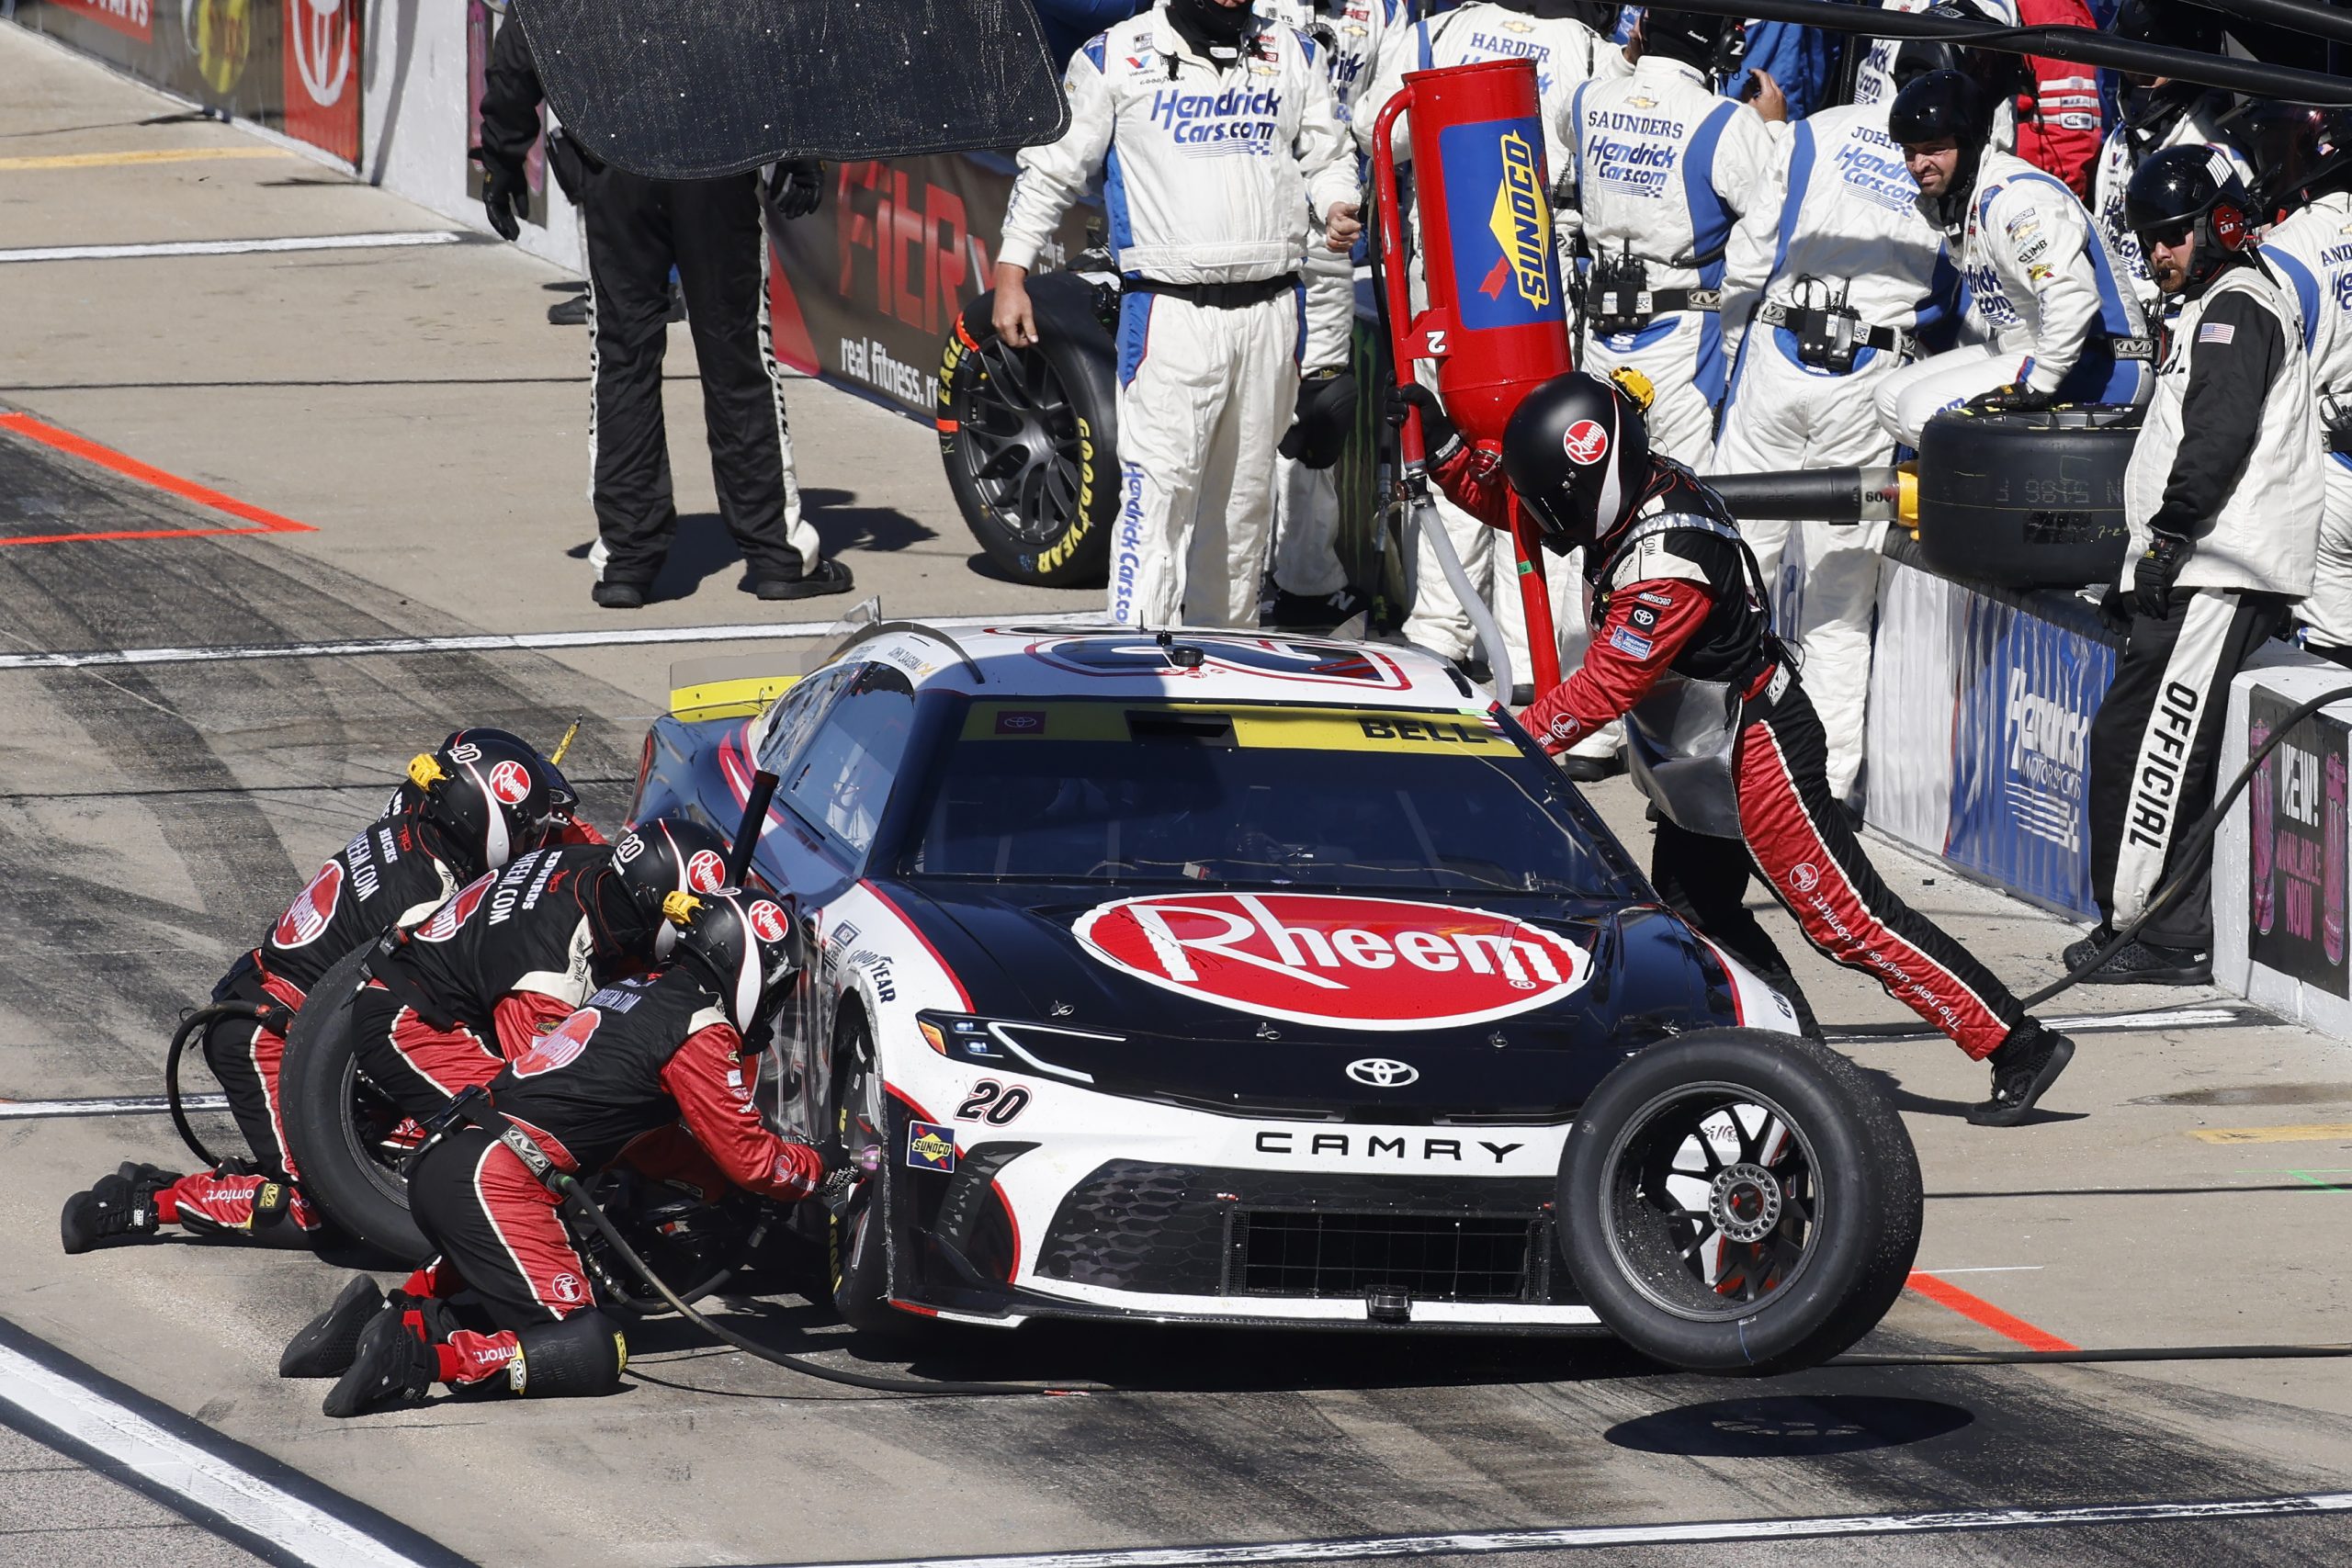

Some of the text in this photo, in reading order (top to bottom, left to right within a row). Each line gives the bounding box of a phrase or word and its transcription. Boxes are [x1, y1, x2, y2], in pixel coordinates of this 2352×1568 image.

[1470, 32, 1551, 63] HARDER
[1150, 86, 1282, 130] Hendrick
[1588, 110, 1685, 140] SAUNDERS
[1174, 120, 1276, 143] Cars.com
[1587, 135, 1678, 170] Hendrick
[1598, 162, 1668, 186] Cars.com
[1505, 138, 1547, 301] SUNOCO
[2018, 239, 2049, 264] CLIMB
[1426, 330, 1447, 354] 2
[1565, 422, 1606, 464] Rheem
[1037, 417, 1095, 574] GOODYEAR
[1639, 592, 1674, 607] NASCAR
[1356, 716, 1489, 744] BELL
[2005, 667, 2089, 773] Hendrick
[447, 742, 482, 764] 20
[2129, 680, 2199, 850] OFFICIAL
[492, 763, 529, 802] Rheem
[2020, 753, 2082, 801] MOTORSPORTS
[2280, 740, 2320, 828] NEW!
[378, 827, 399, 864] HICKS
[616, 833, 645, 863] 20
[2276, 829, 2323, 886] AVAILABLE
[522, 850, 563, 911] EDWARDS
[691, 851, 722, 895] Rheem
[750, 901, 785, 942] Rheem
[2285, 875, 2313, 942] NOW
[1126, 894, 1564, 990] Rheem
[1908, 983, 1940, 1008] new
[1938, 1005, 1963, 1032] The
[955, 1078, 1031, 1127] 20
[913, 1139, 952, 1156] SUNOCO
[1255, 1131, 1525, 1164] CAMRY
[205, 1189, 255, 1203] omfort.
[471, 1345, 518, 1366] mfort.
